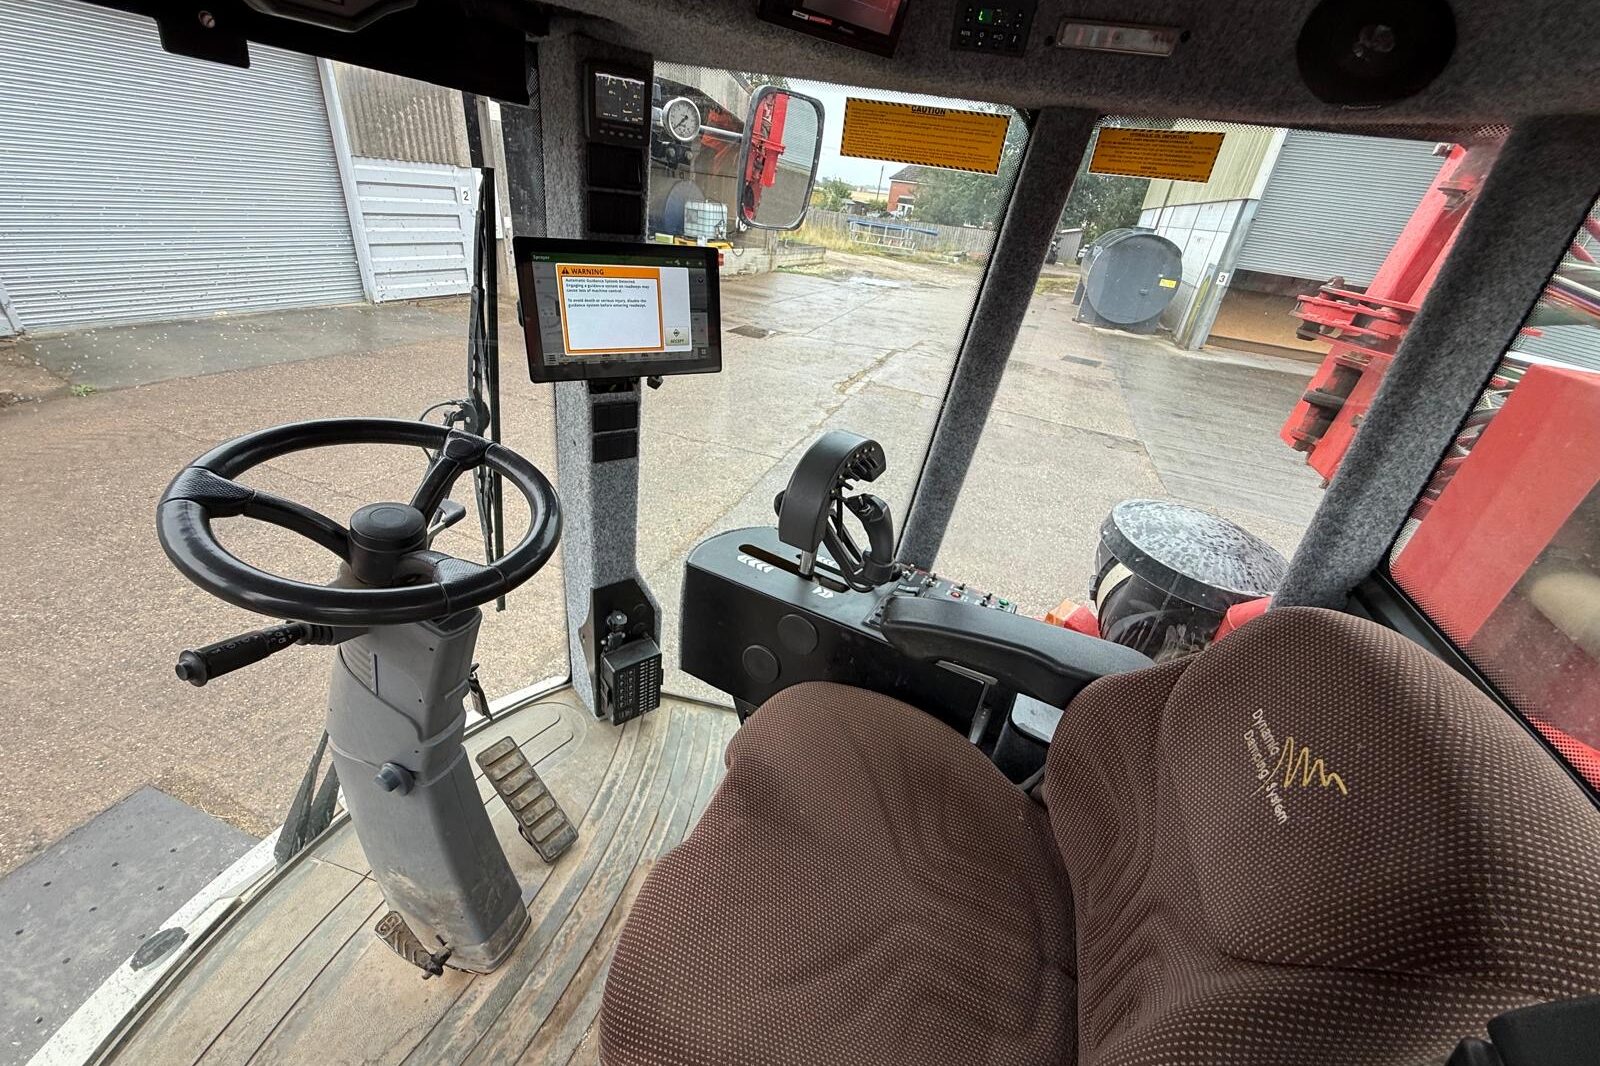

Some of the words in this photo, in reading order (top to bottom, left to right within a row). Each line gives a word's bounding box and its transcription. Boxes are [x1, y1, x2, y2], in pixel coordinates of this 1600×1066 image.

[911, 105, 946, 116] CAUTION
[463, 190, 469, 201] 2
[1252, 708, 1280, 756] Dynamic
[1244, 729, 1269, 780] Damping
[1266, 782, 1288, 825] System
